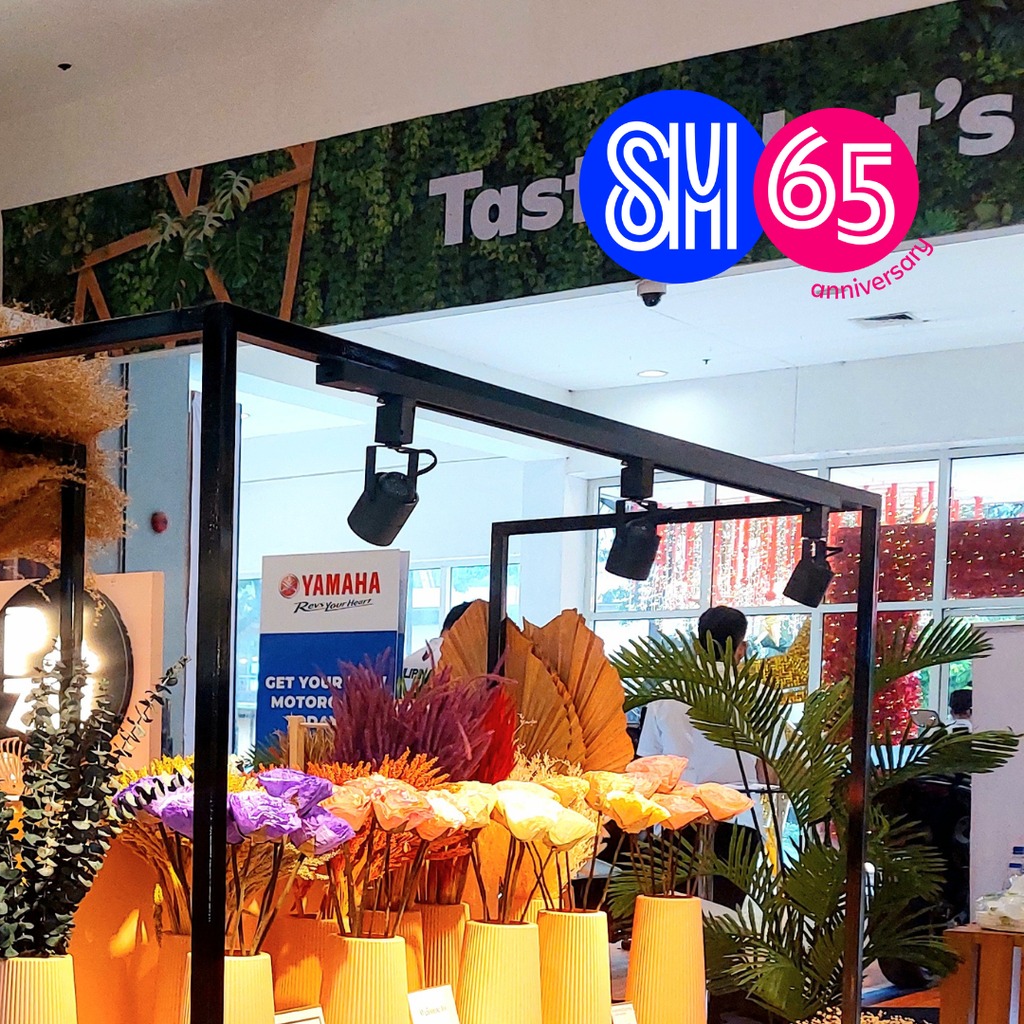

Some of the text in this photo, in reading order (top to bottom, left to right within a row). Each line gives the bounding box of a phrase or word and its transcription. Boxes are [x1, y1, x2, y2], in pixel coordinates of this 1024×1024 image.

[301, 571, 381, 596] YAMAHA
[324, 600, 348, 612] Your
[346, 598, 372, 607] Heart
[265, 675, 295, 689] GET
[298, 675, 343, 689] YOUR
